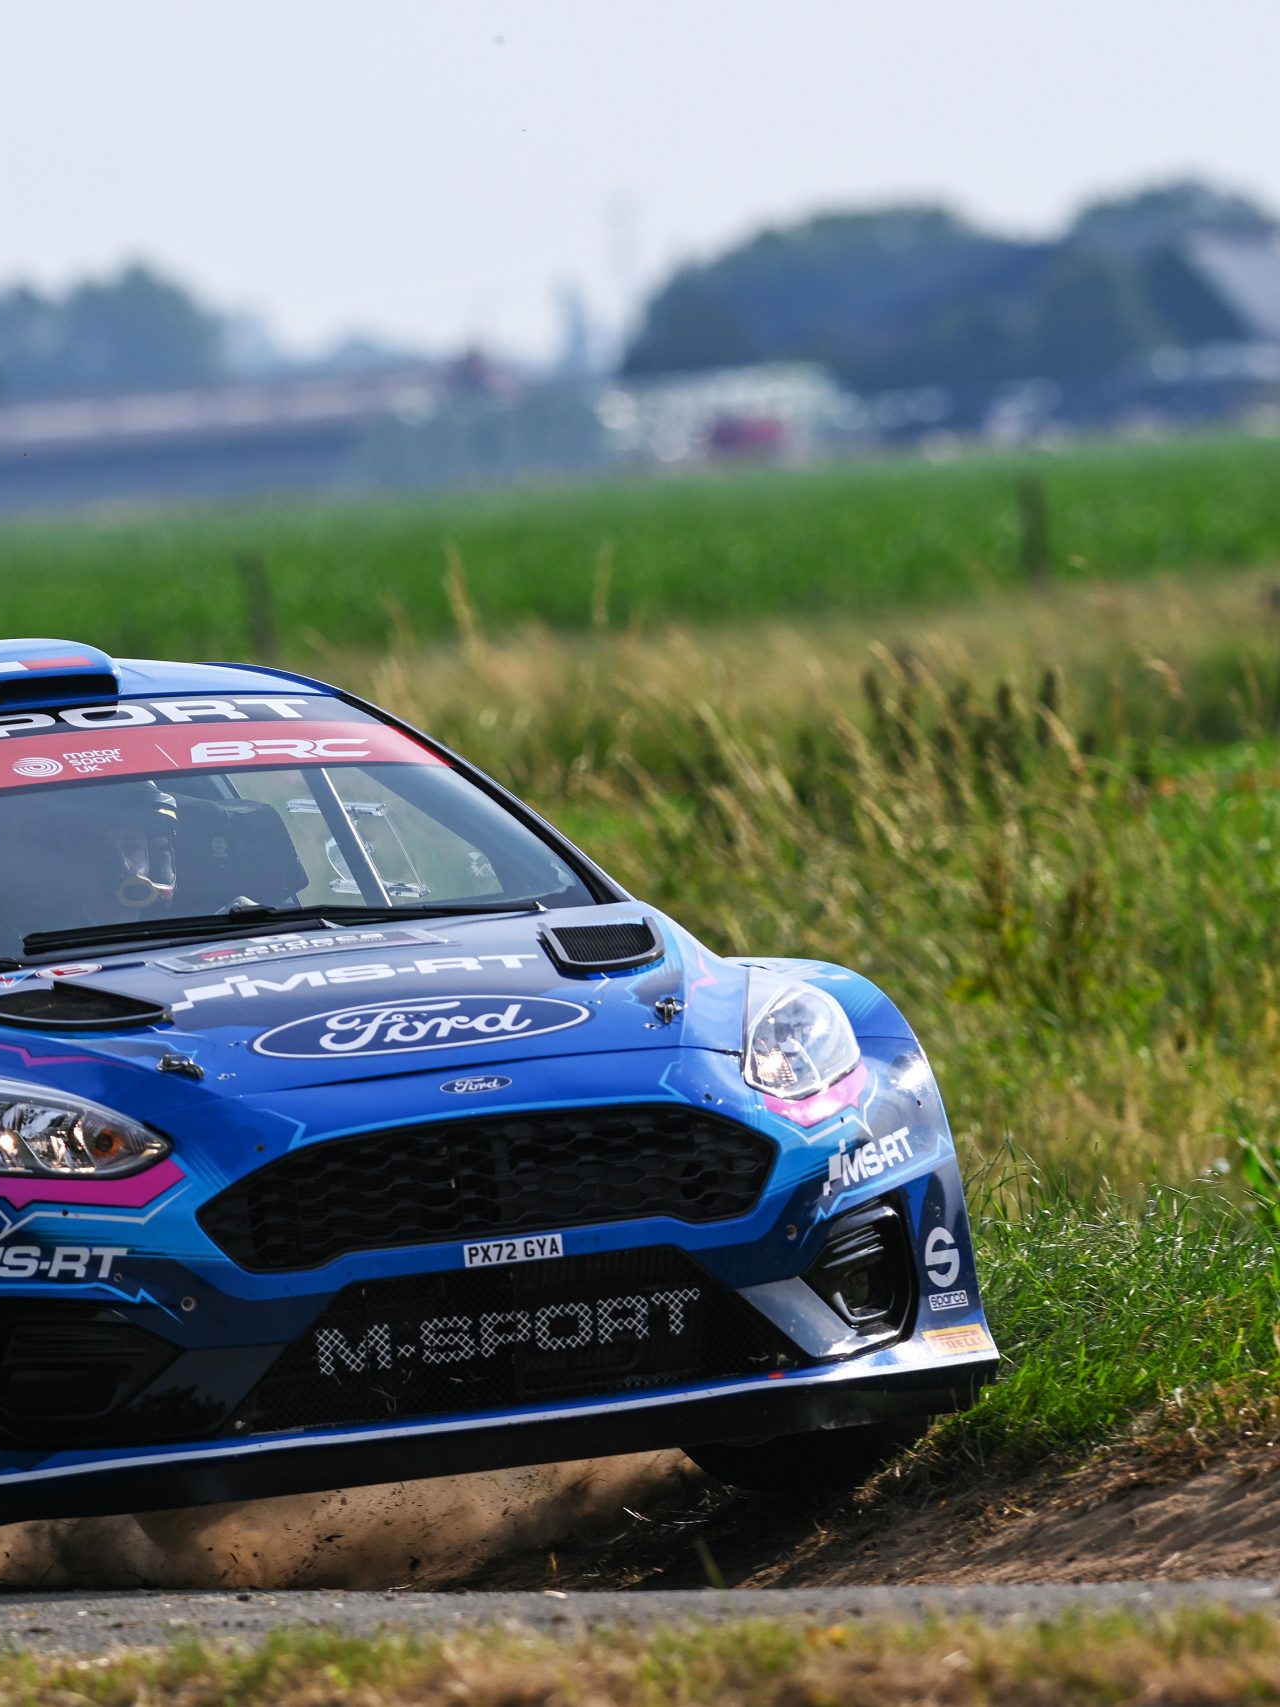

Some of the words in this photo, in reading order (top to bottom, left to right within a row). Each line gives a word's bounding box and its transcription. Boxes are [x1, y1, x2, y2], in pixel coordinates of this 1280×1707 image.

[62, 748, 121, 760] motor
[69, 755, 124, 766] sport
[190, 738, 371, 763] BRC
[236, 954, 538, 998] MS-RT
[320, 1001, 532, 1051] Ford
[453, 1078, 500, 1093] Ford
[841, 1127, 915, 1186] MS-RT
[468, 1243, 517, 1264] PX72
[524, 1237, 561, 1257] GYA
[930, 1290, 967, 1310] sparco
[317, 1288, 700, 1376] M-SPORT
